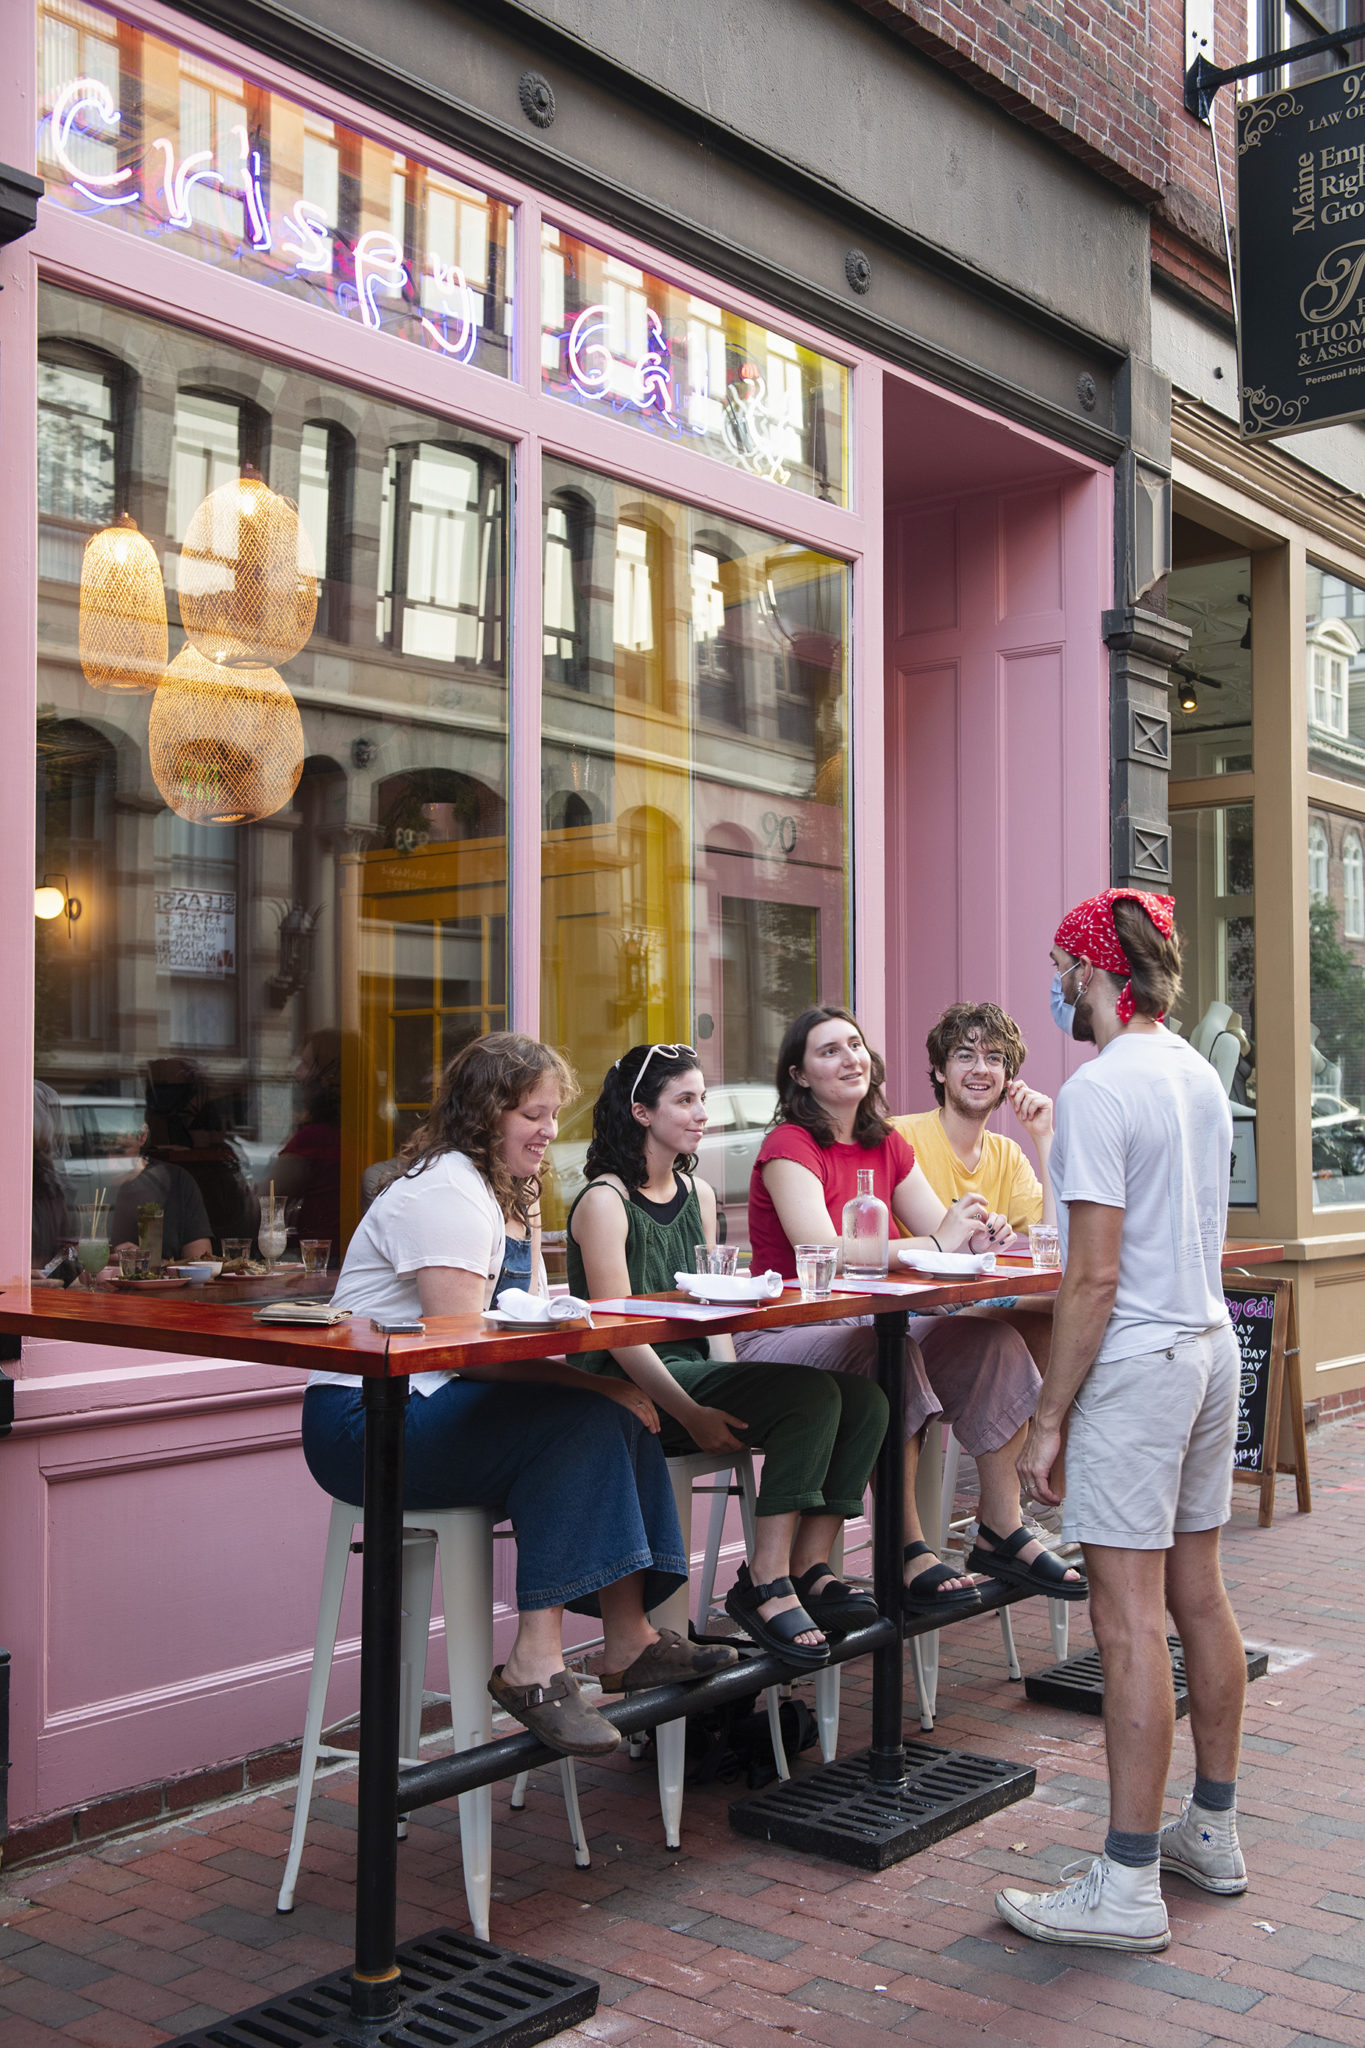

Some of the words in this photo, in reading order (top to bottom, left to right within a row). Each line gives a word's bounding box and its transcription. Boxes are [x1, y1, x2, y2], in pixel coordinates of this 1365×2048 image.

[1307, 109, 1343, 133] LAW
[1292, 151, 1315, 236] Maine
[1320, 200, 1365, 225] Gro
[1298, 352, 1312, 367] &
[1305, 368, 1346, 386] Personal
